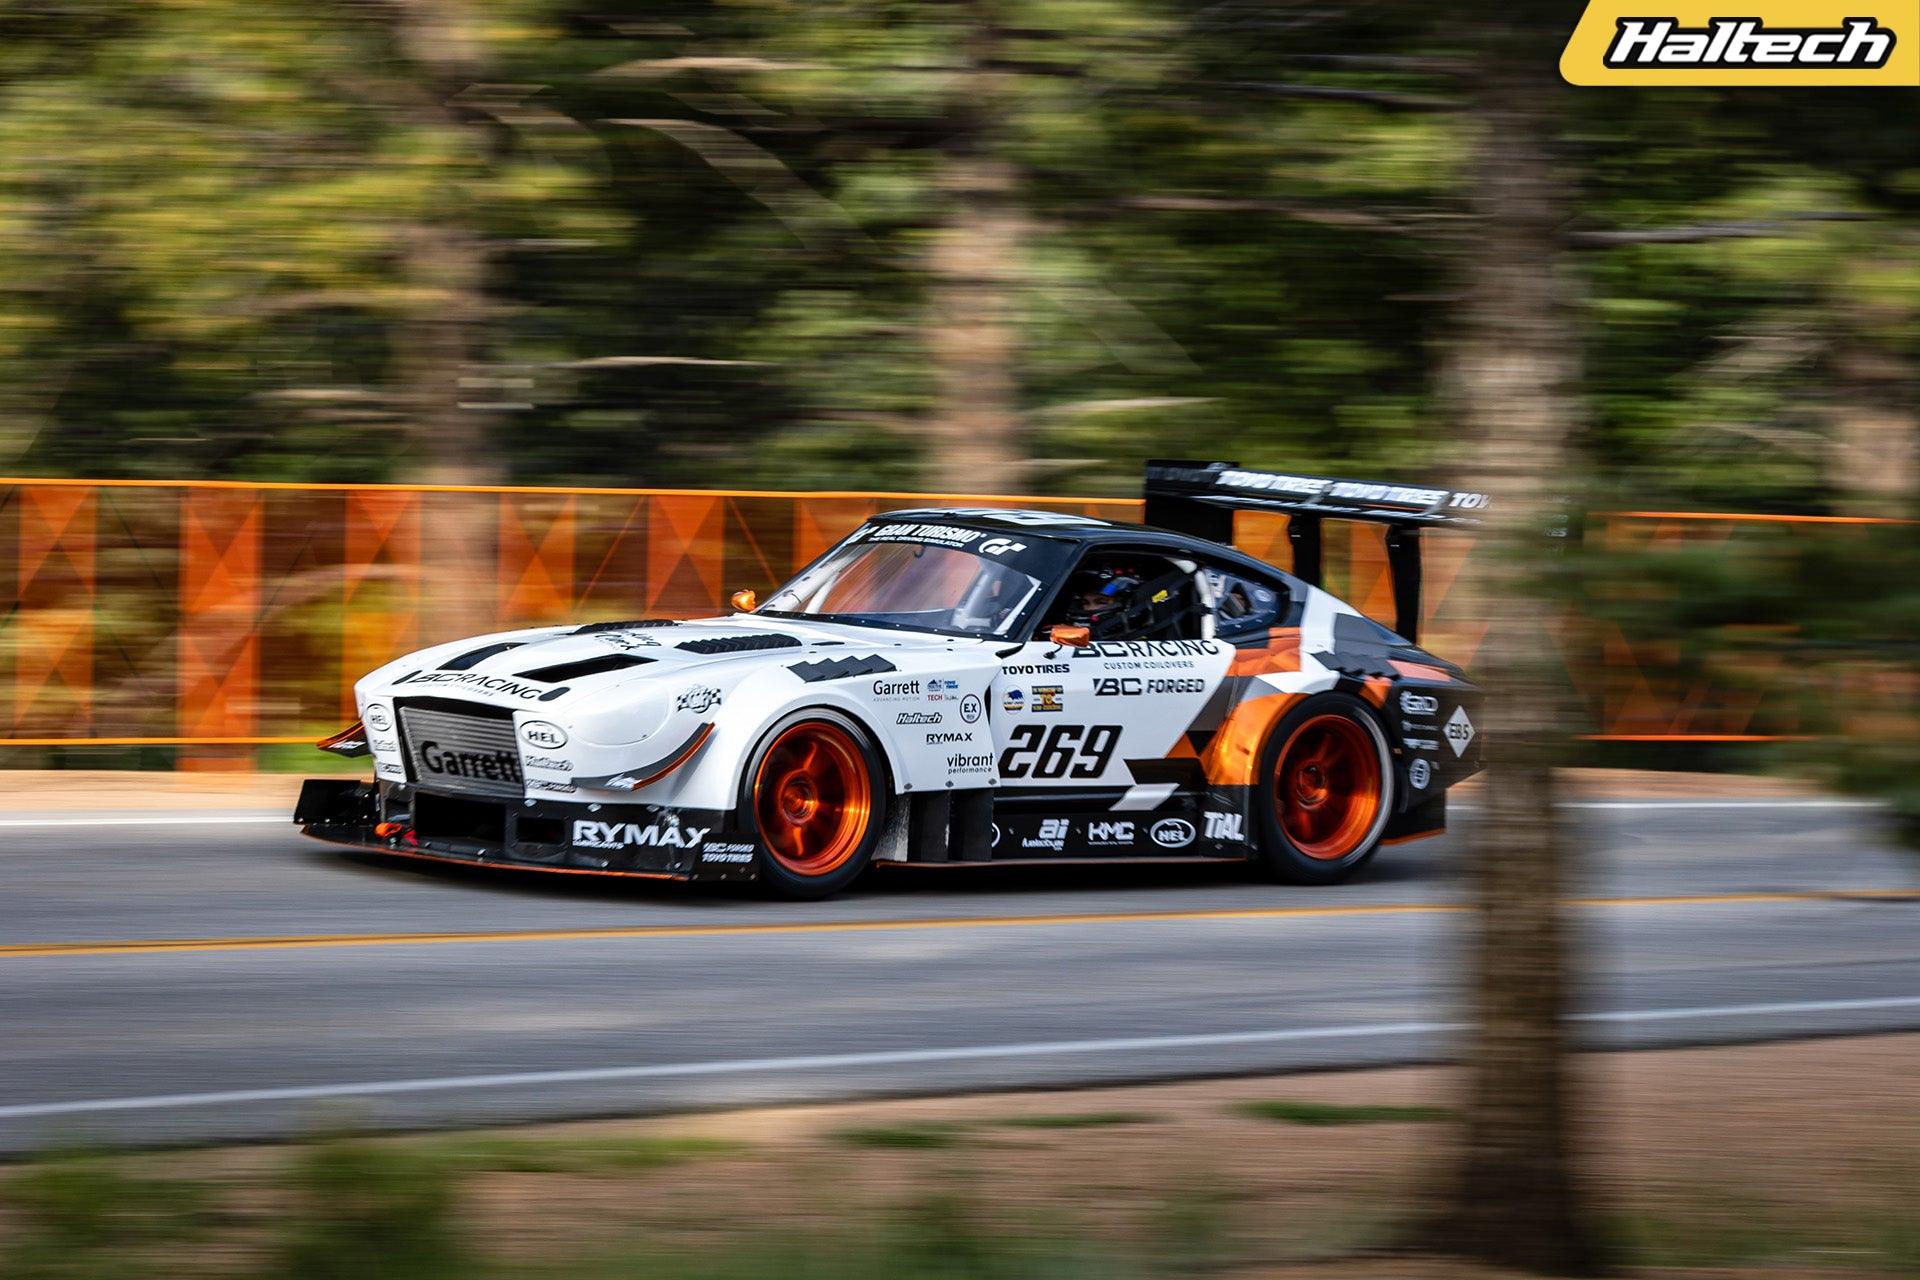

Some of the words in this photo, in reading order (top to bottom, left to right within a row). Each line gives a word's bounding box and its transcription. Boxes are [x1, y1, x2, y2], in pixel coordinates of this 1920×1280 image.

[1002, 665, 1034, 675] TOYO
[1034, 663, 1070, 674] TIRES
[1144, 660, 1195, 668] COILOVERS
[873, 680, 920, 695] Garrett
[1147, 678, 1206, 694] FORGED
[927, 694, 943, 702] TECH
[896, 712, 942, 724] Haltech
[527, 730, 560, 744] HEL
[926, 732, 973, 743] RYMAX
[998, 724, 1123, 779] 269
[420, 740, 521, 783] Garrett
[946, 752, 994, 767] vibrant
[948, 766, 992, 775] performance
[572, 819, 711, 849] RYMAX
